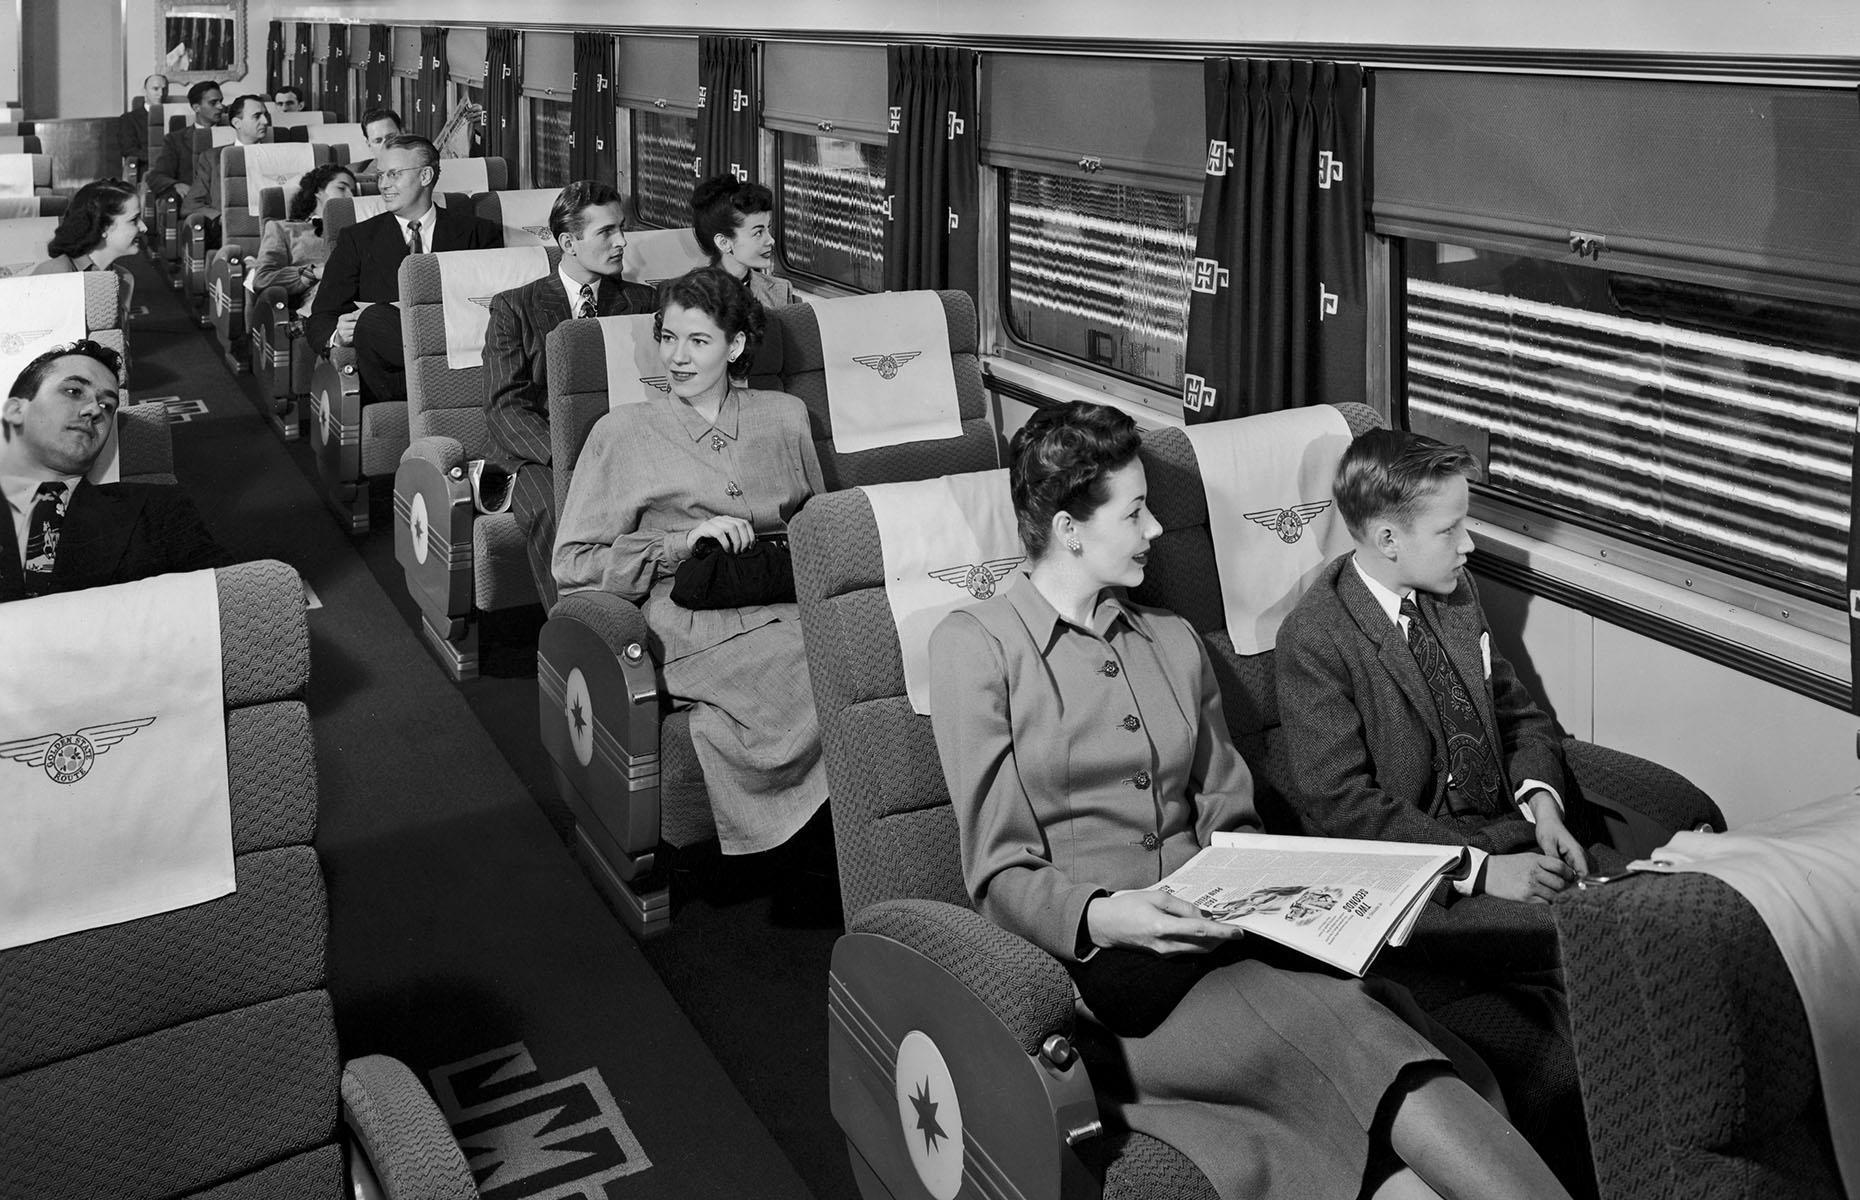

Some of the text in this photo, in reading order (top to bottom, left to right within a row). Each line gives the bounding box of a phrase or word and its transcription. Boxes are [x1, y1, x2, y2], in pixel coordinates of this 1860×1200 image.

[46, 736, 93, 768] GOLDEN STATE
[54, 769, 86, 782] ROUTE
[1342, 888, 1369, 913] SECONDS
[1354, 902, 1372, 918] TWO
